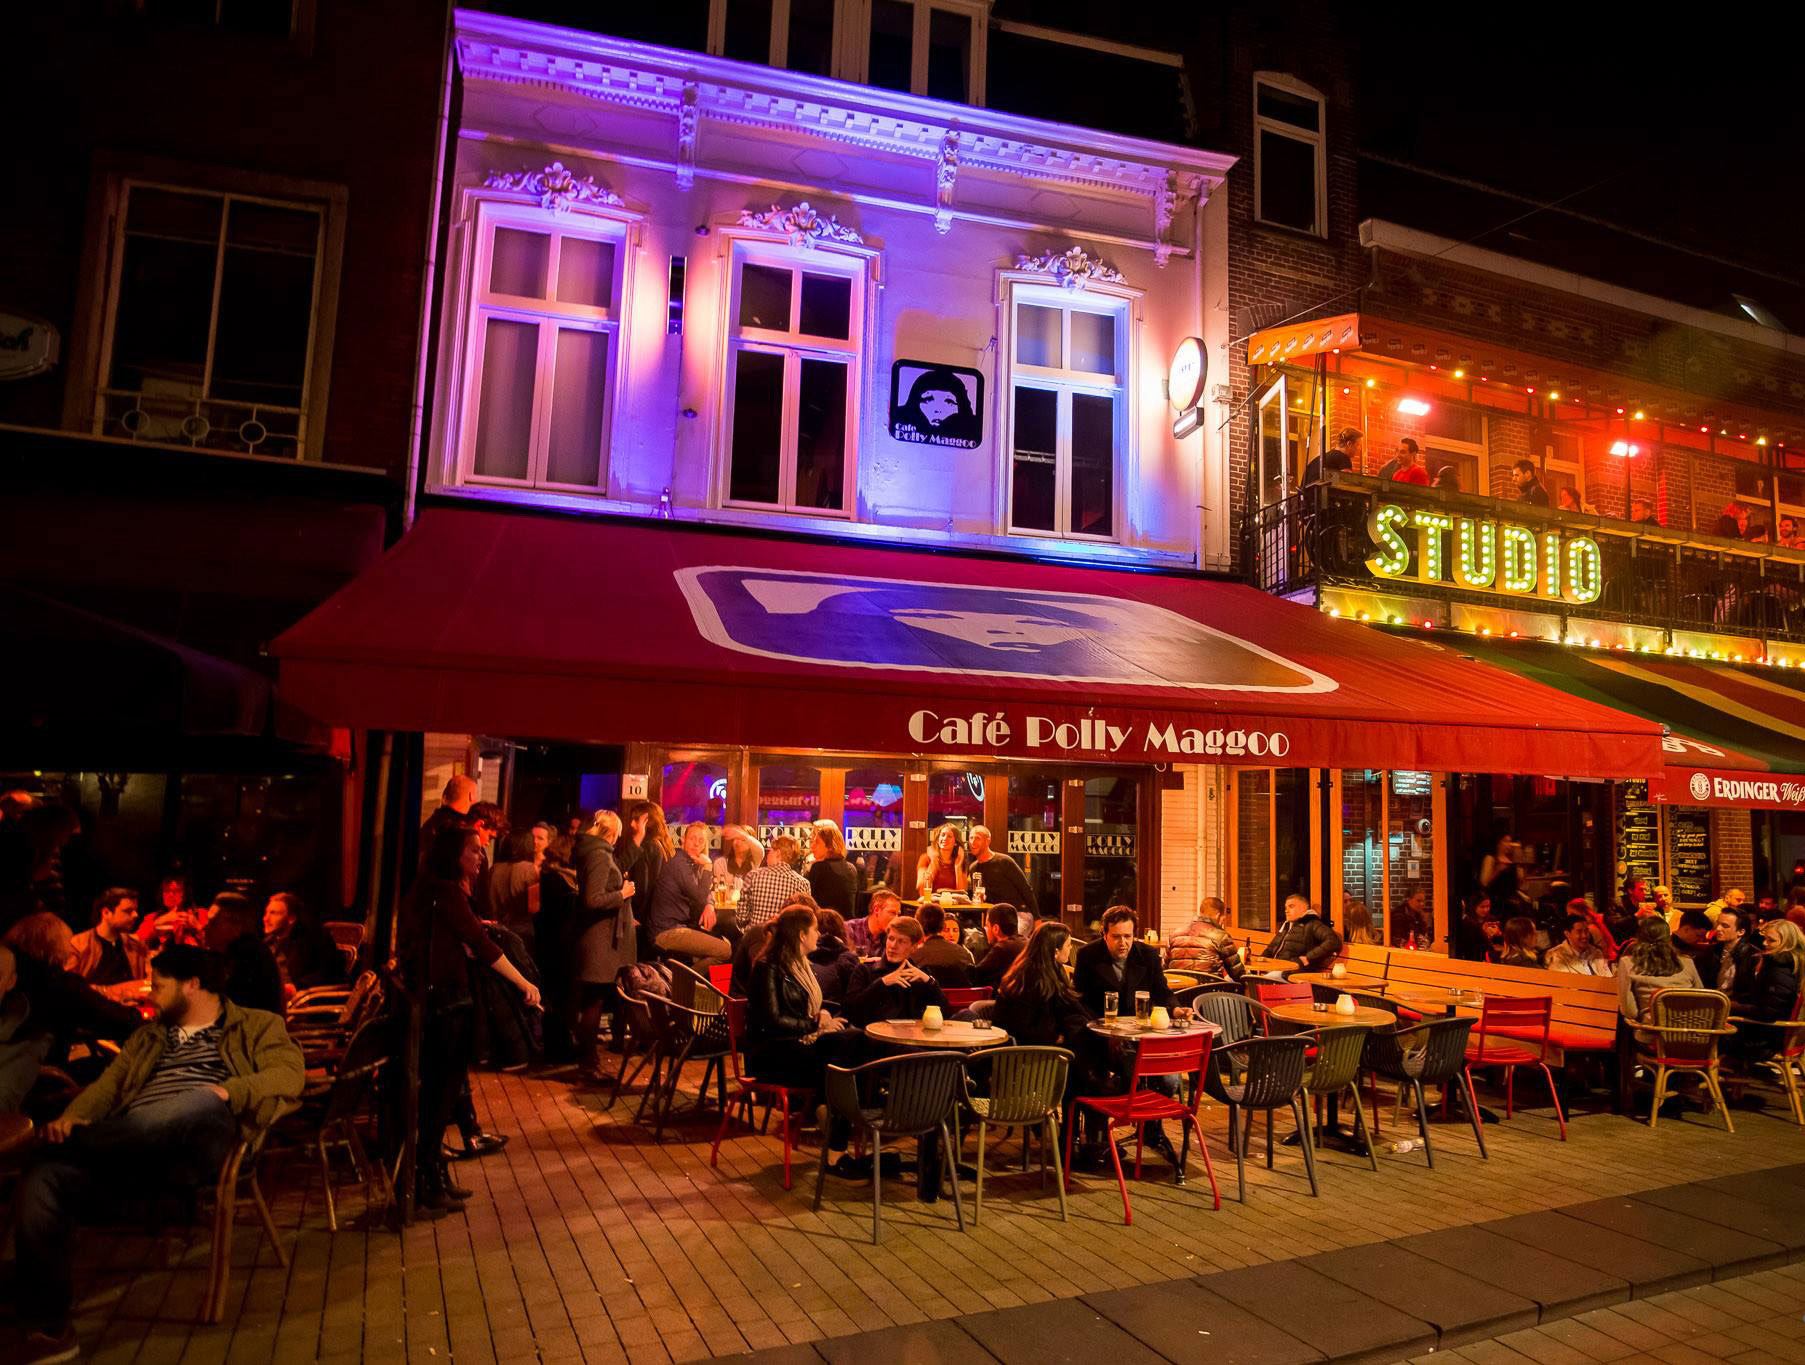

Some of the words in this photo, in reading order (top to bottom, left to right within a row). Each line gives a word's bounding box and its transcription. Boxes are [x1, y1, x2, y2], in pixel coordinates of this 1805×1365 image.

[895, 430, 927, 443] Polly
[929, 434, 977, 448] Maggoo
[1366, 504, 1601, 604] STUDIO
[908, 710, 1011, 747] Café
[1026, 716, 1133, 752] Polly
[1143, 722, 1290, 757] Maggoo
[629, 785, 642, 795] 10
[1713, 777, 1781, 803] ERDINGER
[847, 829, 898, 841] POLLY
[1009, 832, 1057, 843] POLLY
[1087, 835, 1133, 847] POLLY
